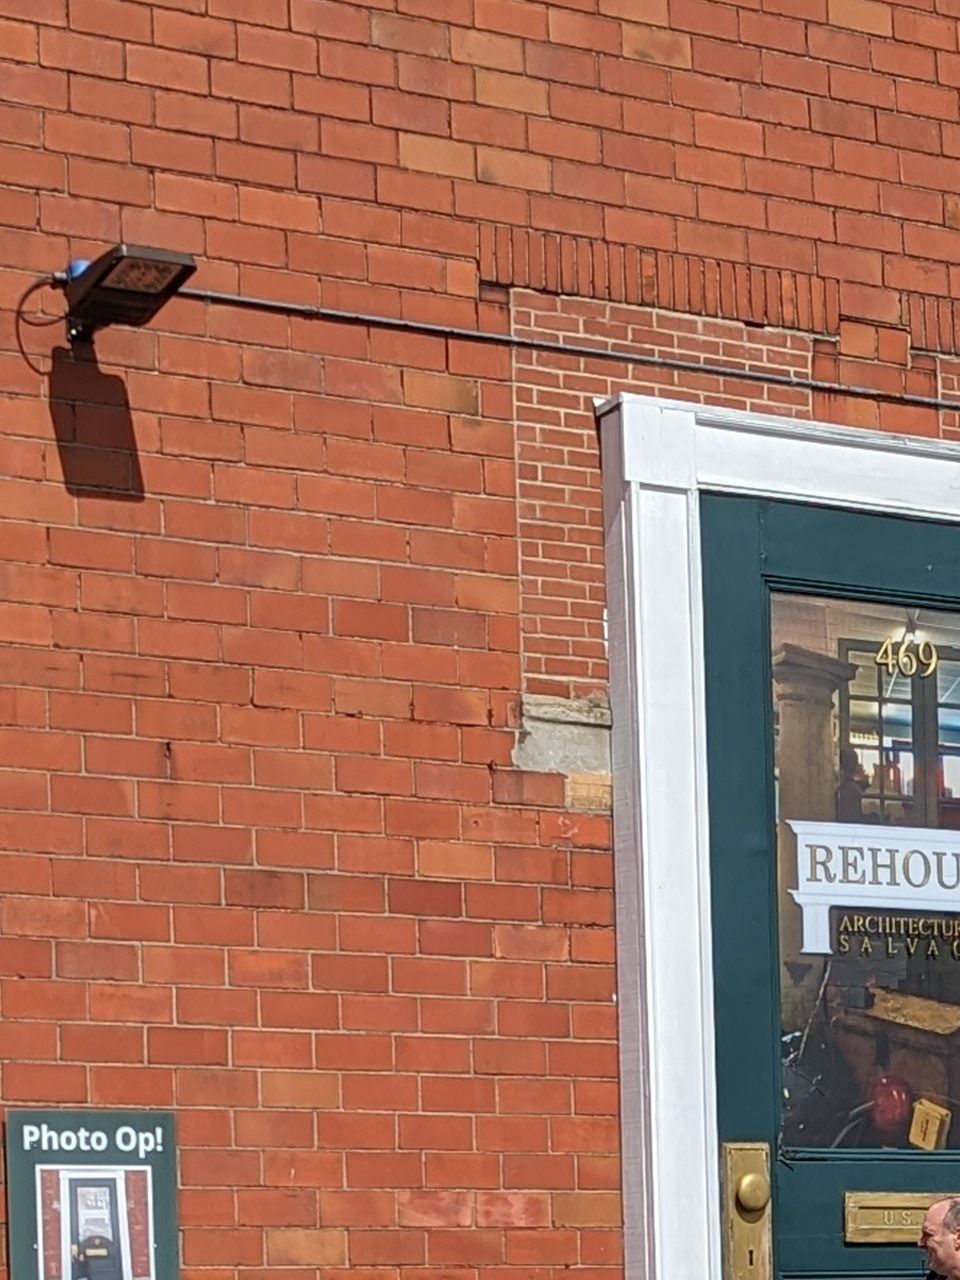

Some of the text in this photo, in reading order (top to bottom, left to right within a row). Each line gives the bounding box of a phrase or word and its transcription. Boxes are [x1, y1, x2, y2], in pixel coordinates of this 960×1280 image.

[875, 637, 938, 677] 469
[22, 1124, 164, 1158] Photo Op!
